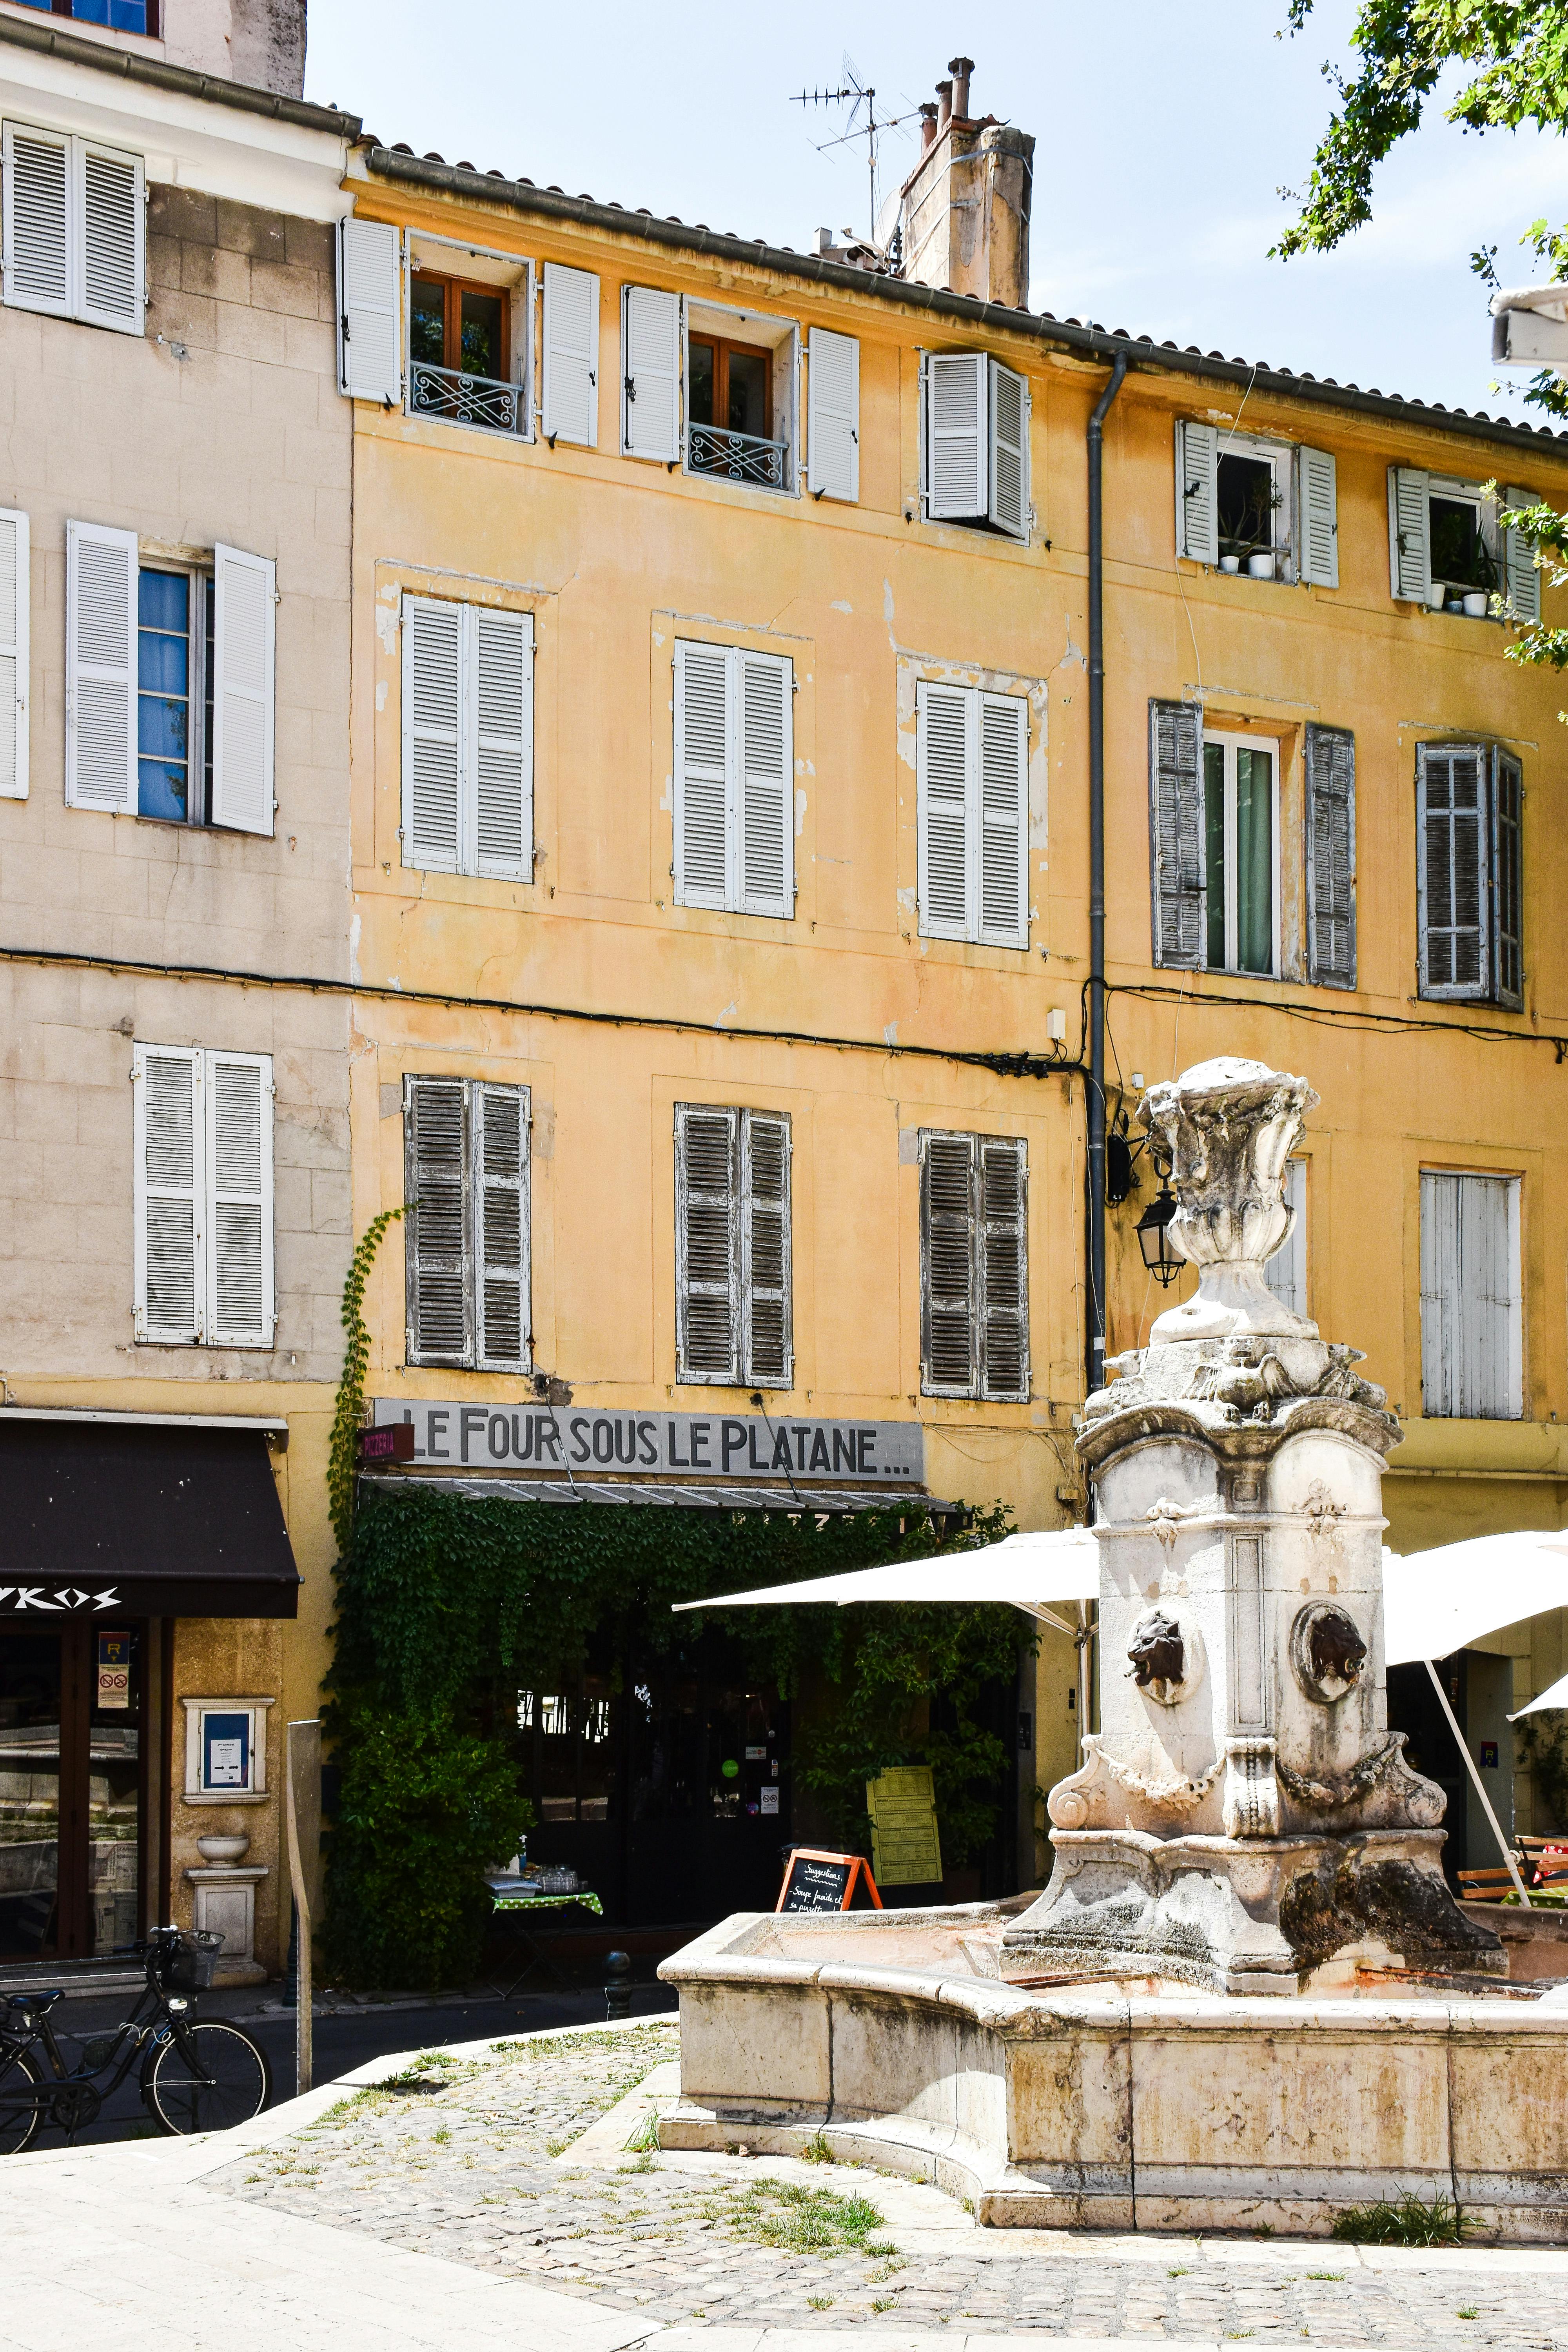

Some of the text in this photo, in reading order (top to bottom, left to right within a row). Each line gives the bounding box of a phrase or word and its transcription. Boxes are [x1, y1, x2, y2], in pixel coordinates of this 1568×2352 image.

[460, 1408, 559, 1462] FOUR
[570, 1417, 658, 1465] SOUS
[668, 1421, 711, 1467] LE
[804, 1864, 840, 1880] Suggestions
[812, 1890, 833, 1905] froide
[835, 1895, 843, 1904] et
